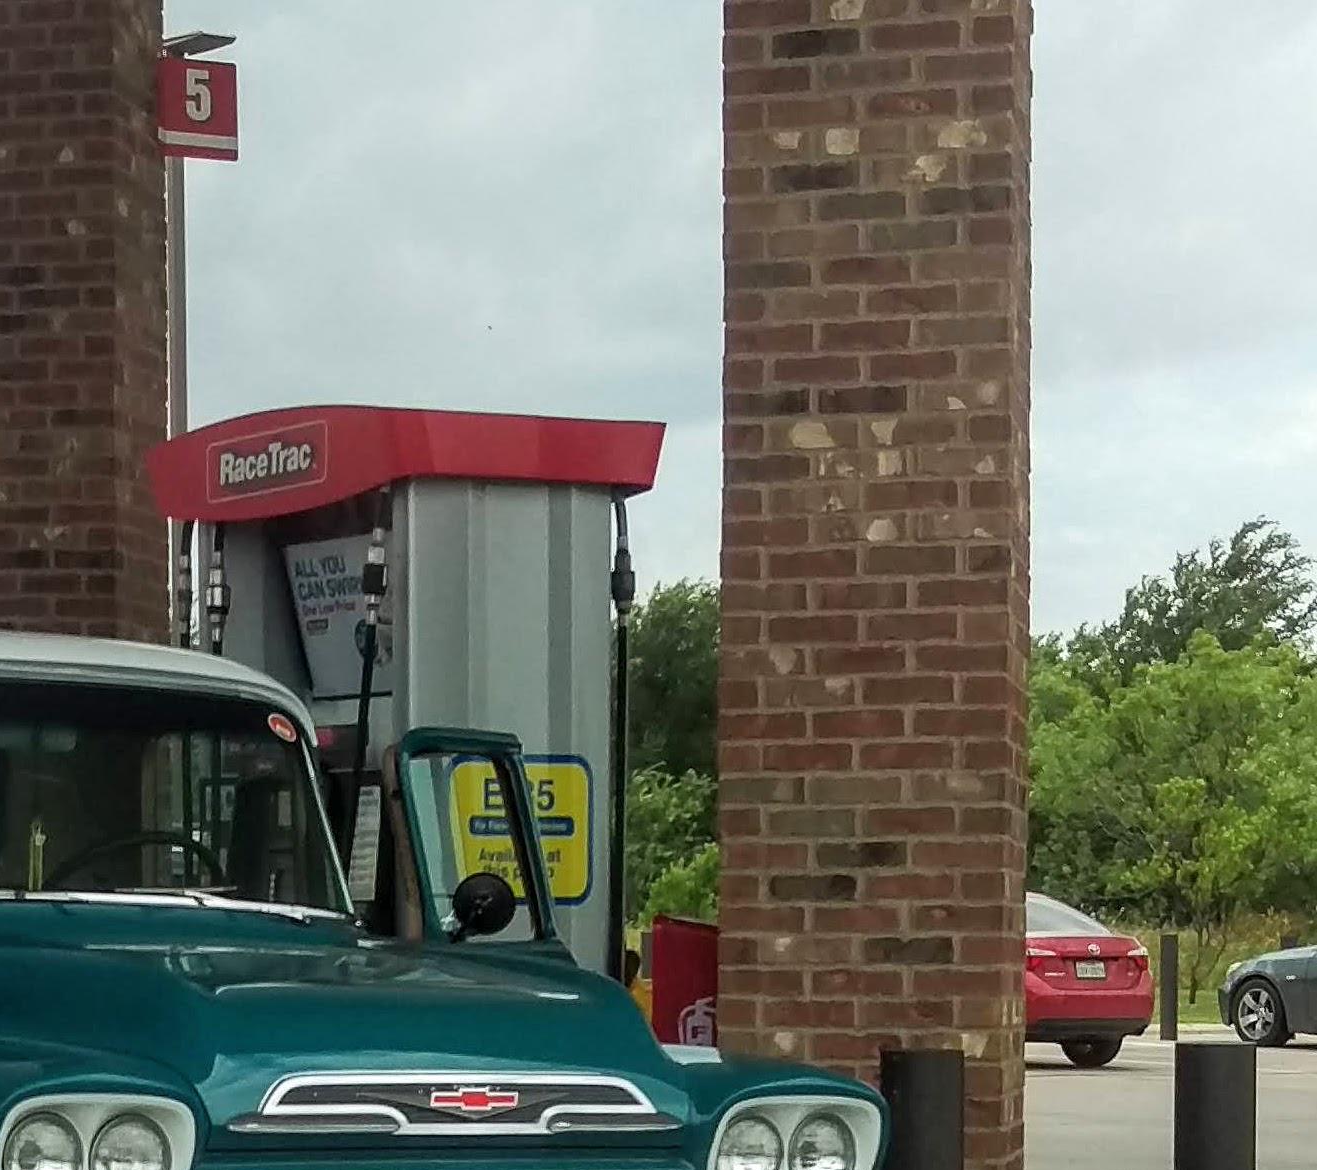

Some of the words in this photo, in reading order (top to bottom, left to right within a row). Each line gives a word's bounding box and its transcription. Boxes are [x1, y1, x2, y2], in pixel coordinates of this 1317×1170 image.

[185, 69, 212, 122] 5
[220, 441, 312, 486] RaceTrac
[295, 558, 319, 578] ALL
[319, 555, 346, 575] YOU
[298, 580, 325, 601] CAN
[326, 577, 363, 598] SWIR
[485, 778, 556, 811] E5
